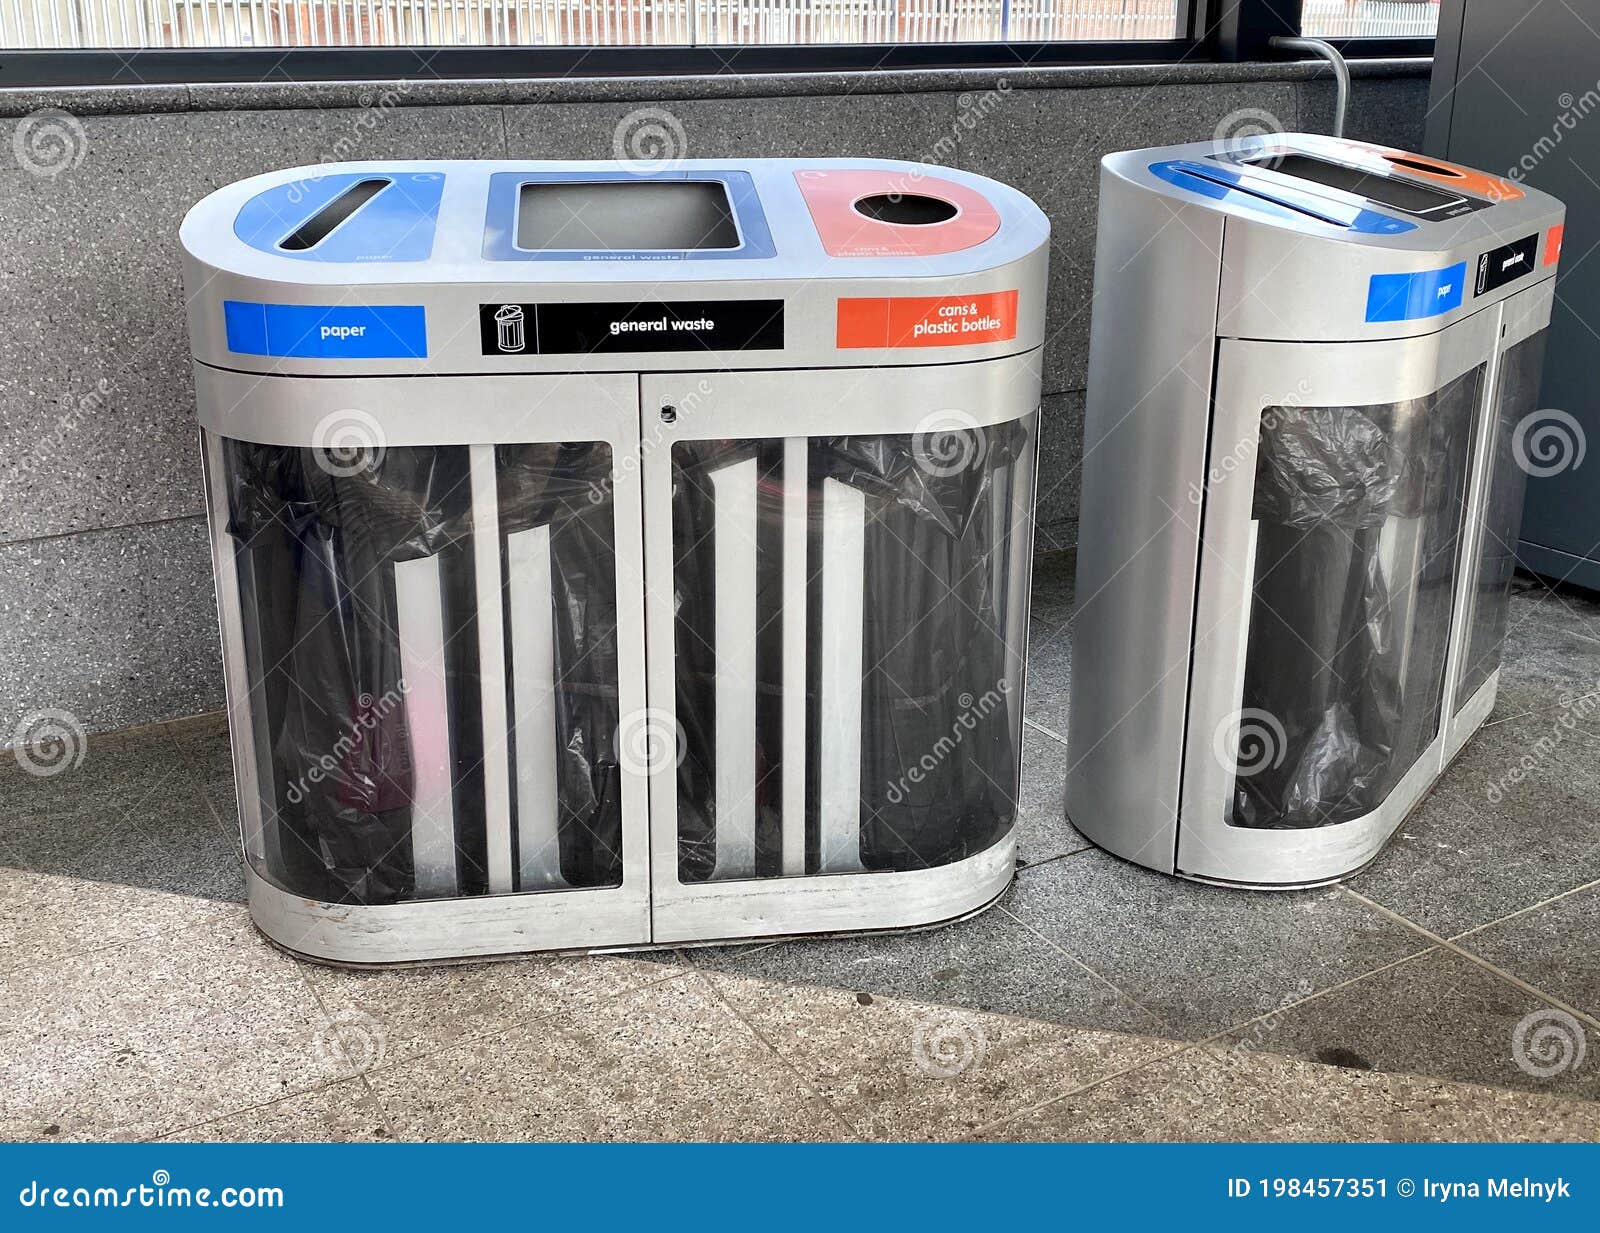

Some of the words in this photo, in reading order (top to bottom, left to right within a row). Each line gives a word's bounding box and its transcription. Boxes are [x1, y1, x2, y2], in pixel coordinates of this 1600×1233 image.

[938, 305, 968, 317] cans
[969, 303, 978, 315] &
[320, 326, 367, 340] paper
[610, 317, 668, 335] general
[671, 318, 715, 331] waste
[914, 319, 958, 338] plastic
[961, 316, 1001, 333] bottles
